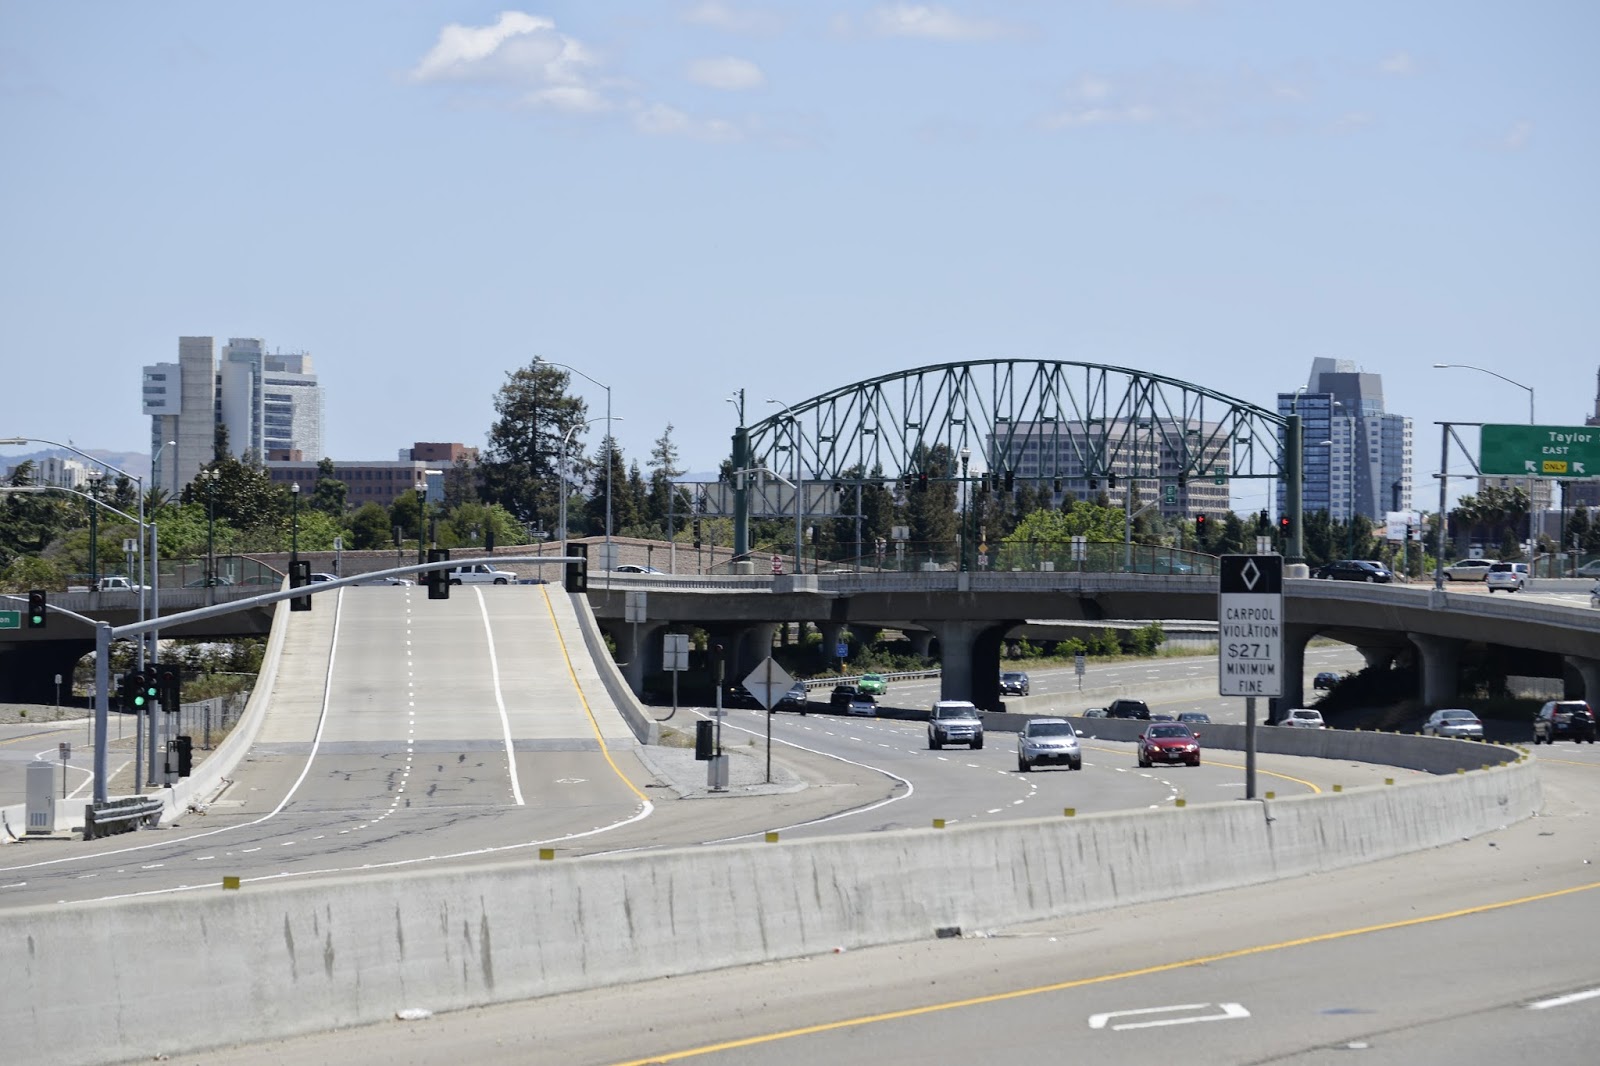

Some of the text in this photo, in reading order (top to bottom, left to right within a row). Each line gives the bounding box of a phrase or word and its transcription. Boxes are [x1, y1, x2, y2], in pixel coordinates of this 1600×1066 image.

[1549, 431, 1592, 444] Taylor
[1542, 446, 1569, 455] EAST
[1544, 463, 1566, 471] ONLY
[1226, 608, 1275, 620] CARPOOL
[1223, 624, 1278, 638] VIOLATION
[1228, 643, 1270, 658] $271
[1227, 663, 1275, 675] MINIMUM
[1239, 681, 1263, 693] FINE
